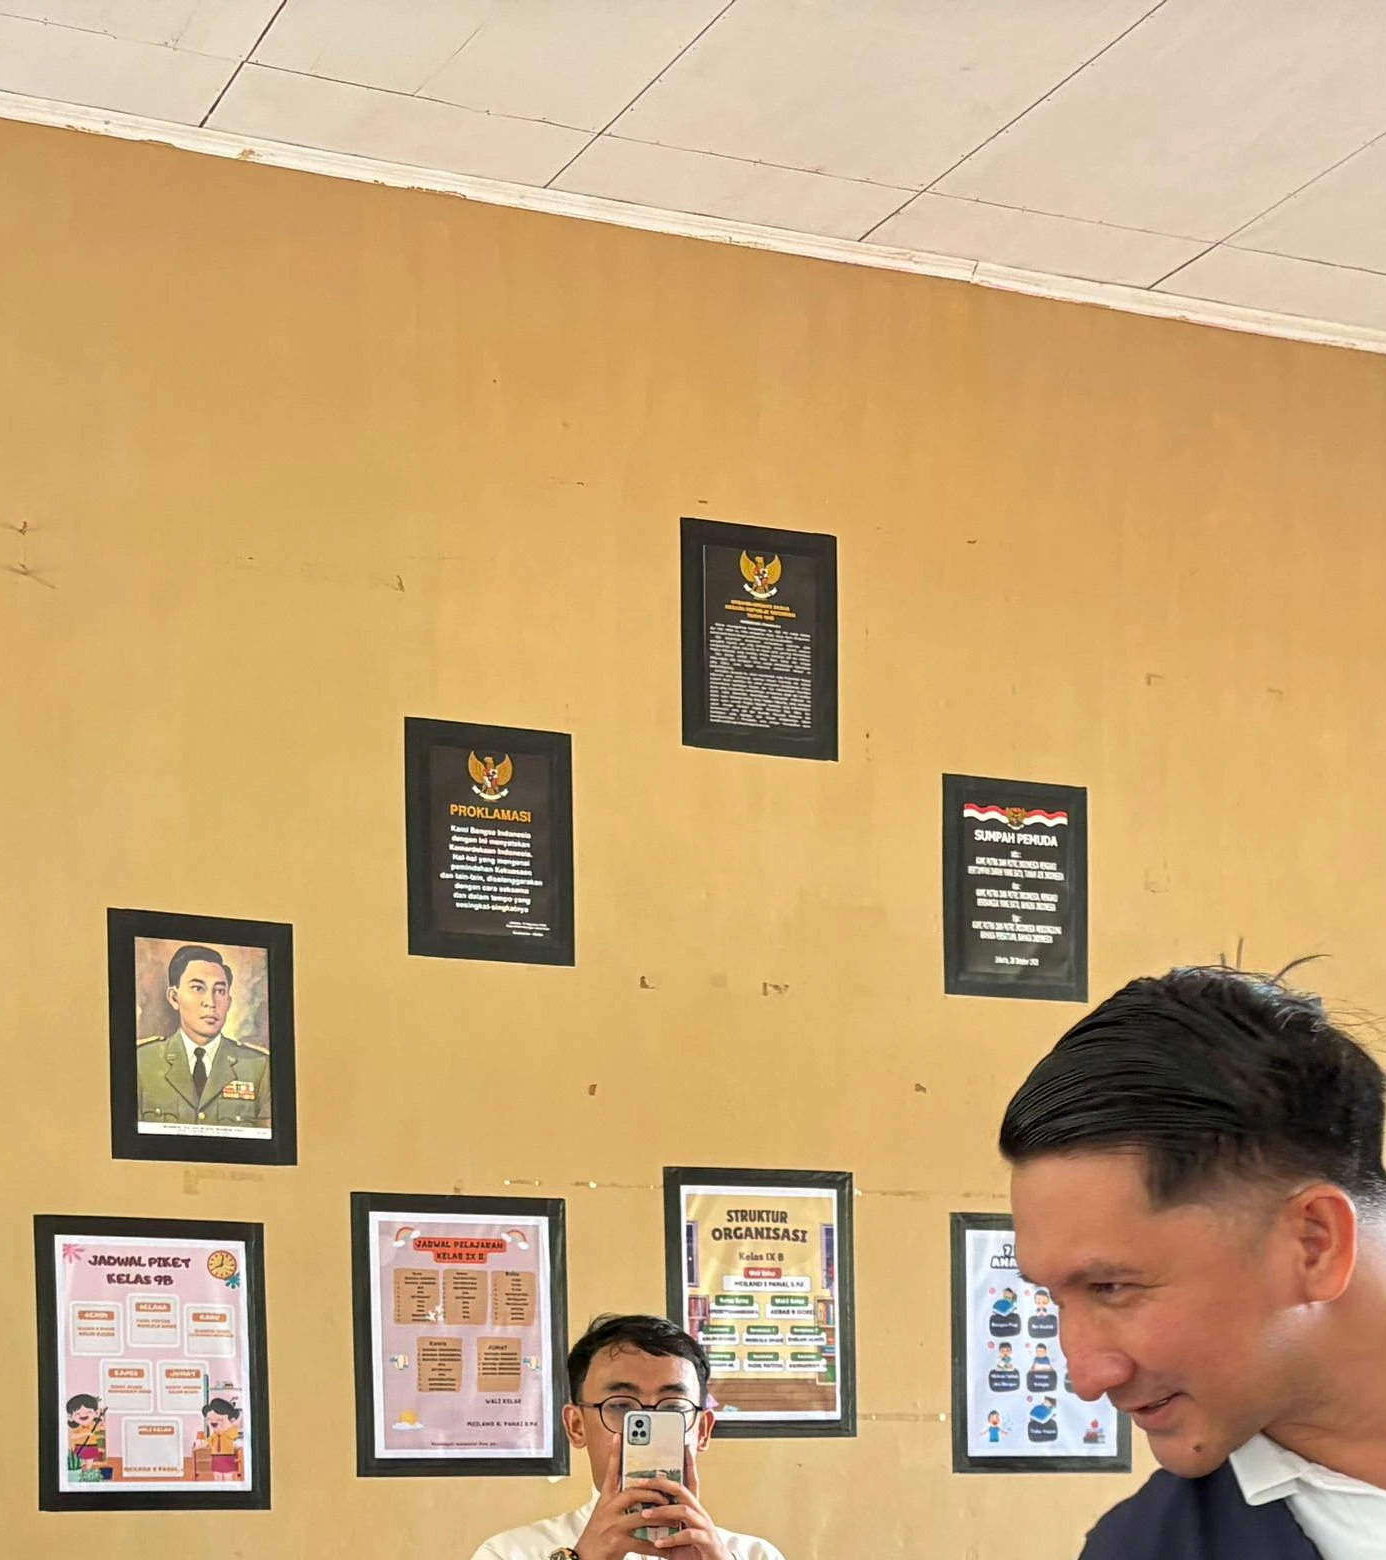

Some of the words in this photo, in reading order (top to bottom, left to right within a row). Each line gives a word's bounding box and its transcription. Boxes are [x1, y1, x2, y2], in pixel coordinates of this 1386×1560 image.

[450, 804, 532, 823] PROKLAMASI
[497, 829, 532, 839] Indonesia
[974, 829, 1015, 844] SUMPAH
[1016, 833, 1058, 847] PEMUDA
[726, 1209, 788, 1223] STRUKTUR
[712, 1226, 808, 1243] ORGANISASI
[416, 1240, 451, 1248] JADWAL
[454, 1241, 503, 1250] PELAJARAN
[1003, 1244, 1012, 1257] 7
[88, 1254, 146, 1268] JADWAL
[148, 1256, 192, 1269] PIKET
[739, 1252, 764, 1261] Kelas
[766, 1252, 776, 1261] IX
[778, 1252, 784, 1262] B
[990, 1256, 1019, 1269] ANA
[106, 1273, 152, 1286] KELAS
[154, 1274, 174, 1286] 9B
